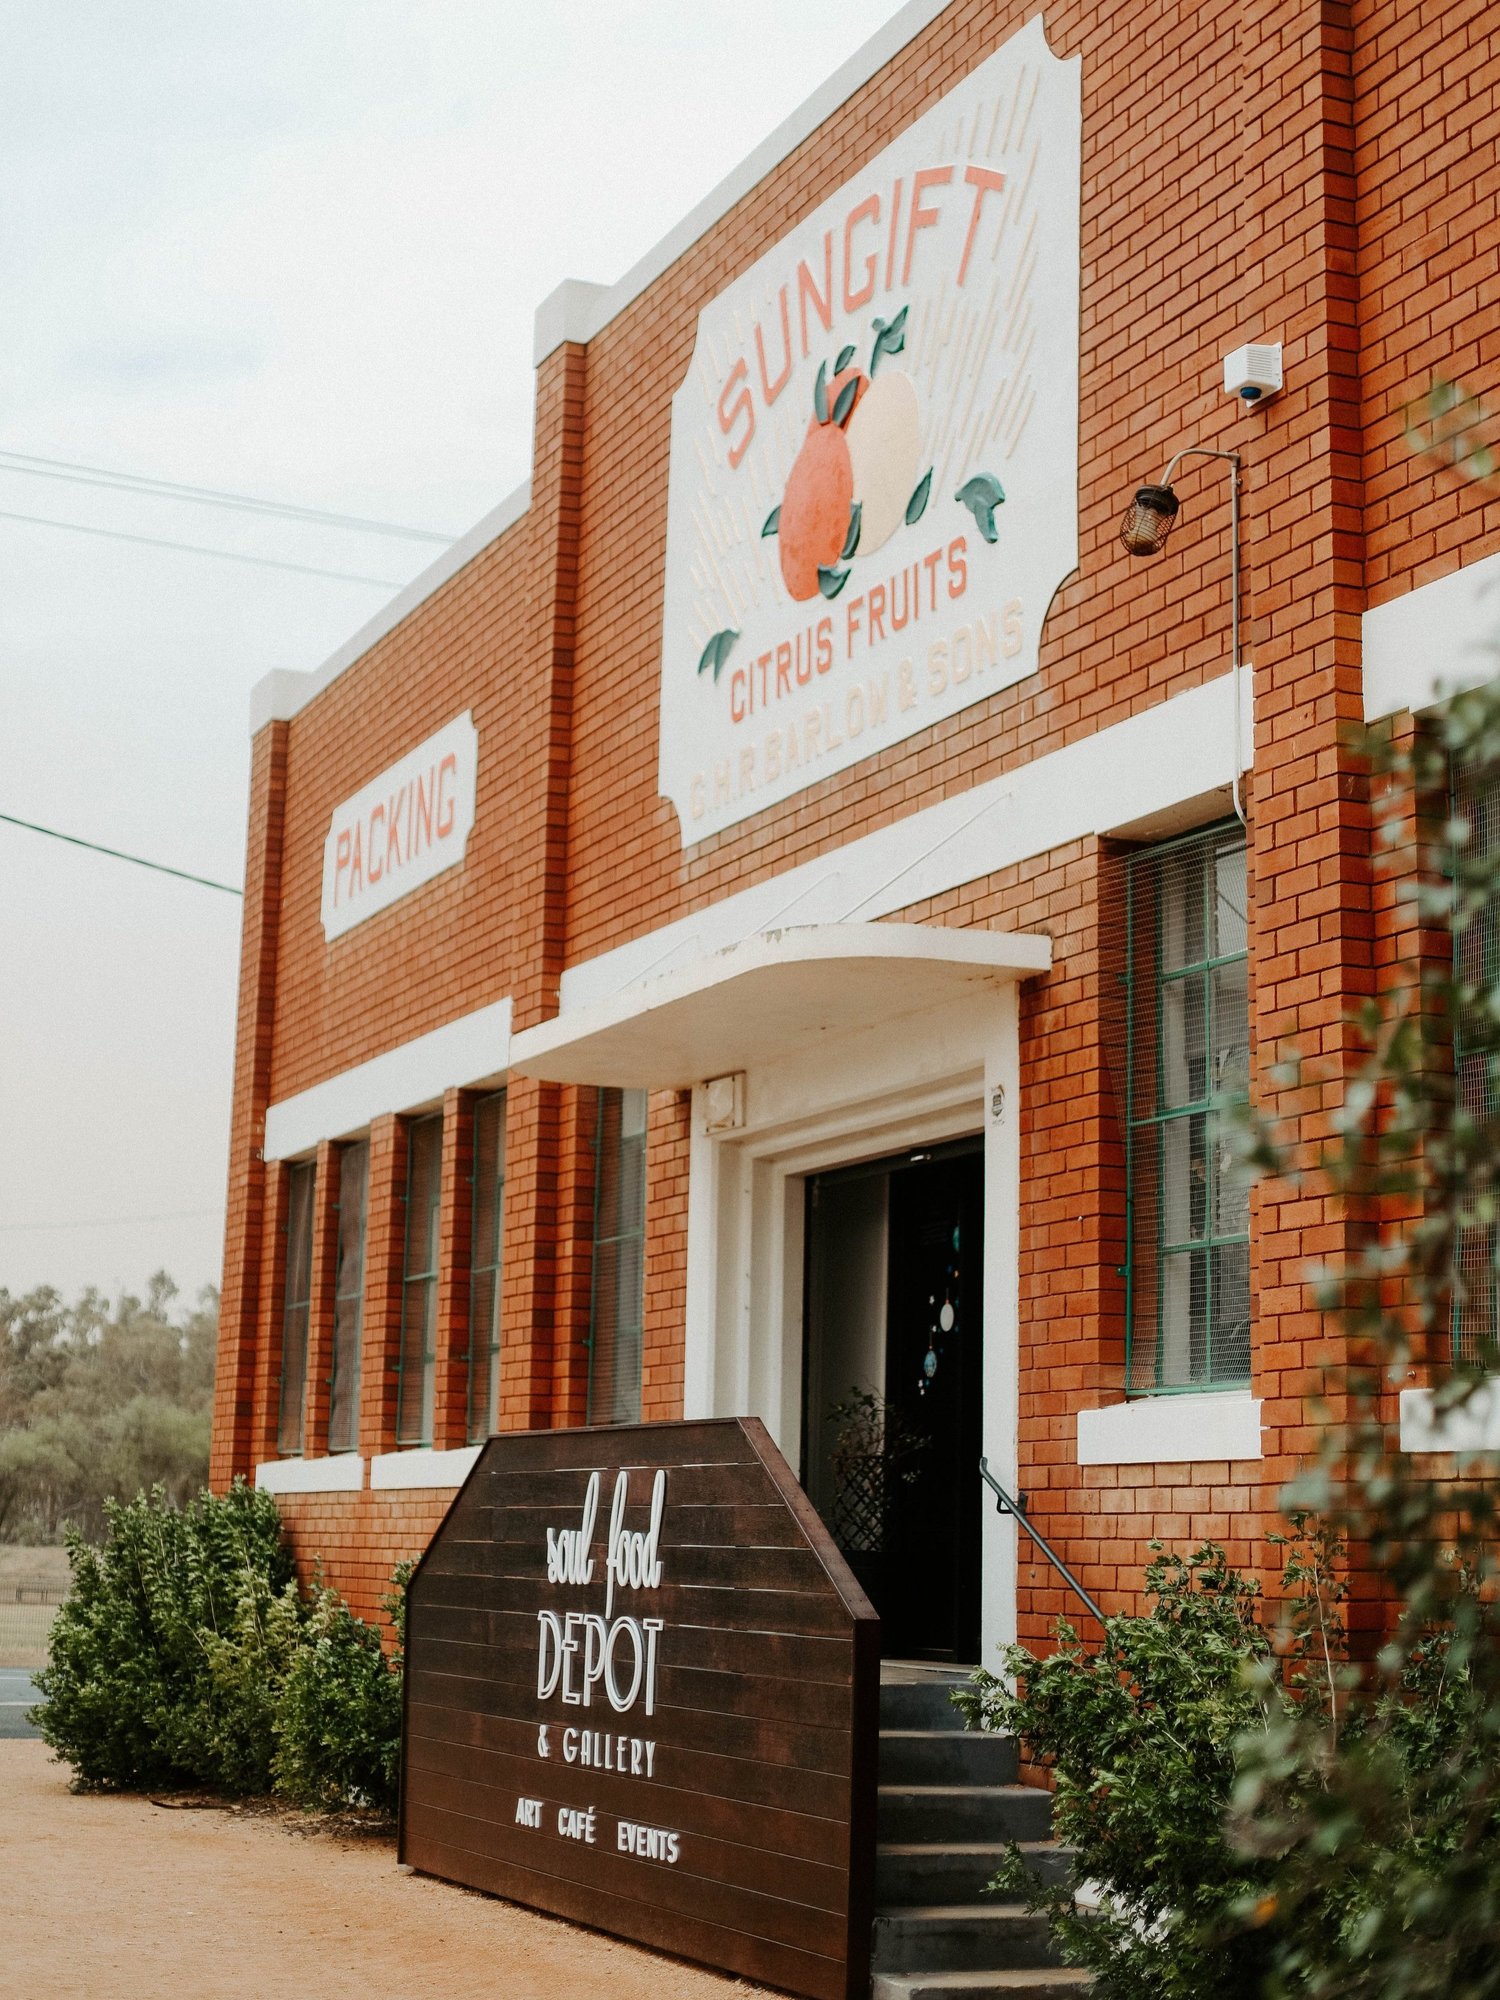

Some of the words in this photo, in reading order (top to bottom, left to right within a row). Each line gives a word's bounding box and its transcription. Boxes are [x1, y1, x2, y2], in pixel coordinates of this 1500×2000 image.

[717, 164, 1006, 470] SUNGIFT
[730, 616, 834, 724] CITRUS
[847, 535, 968, 659] FRUITS
[897, 656, 919, 714] &
[926, 597, 1025, 698] SONS
[333, 751, 457, 909] PACKING
[546, 1471, 600, 1585] soul
[605, 1469, 665, 1620] food
[537, 1609, 664, 1717] DEPOT
[537, 1724, 550, 1758] &
[562, 1727, 657, 1778] GALLERY
[515, 1797, 543, 1829] ART
[557, 1805, 597, 1844] CAFÉ
[617, 1821, 680, 1864] EVENTS
